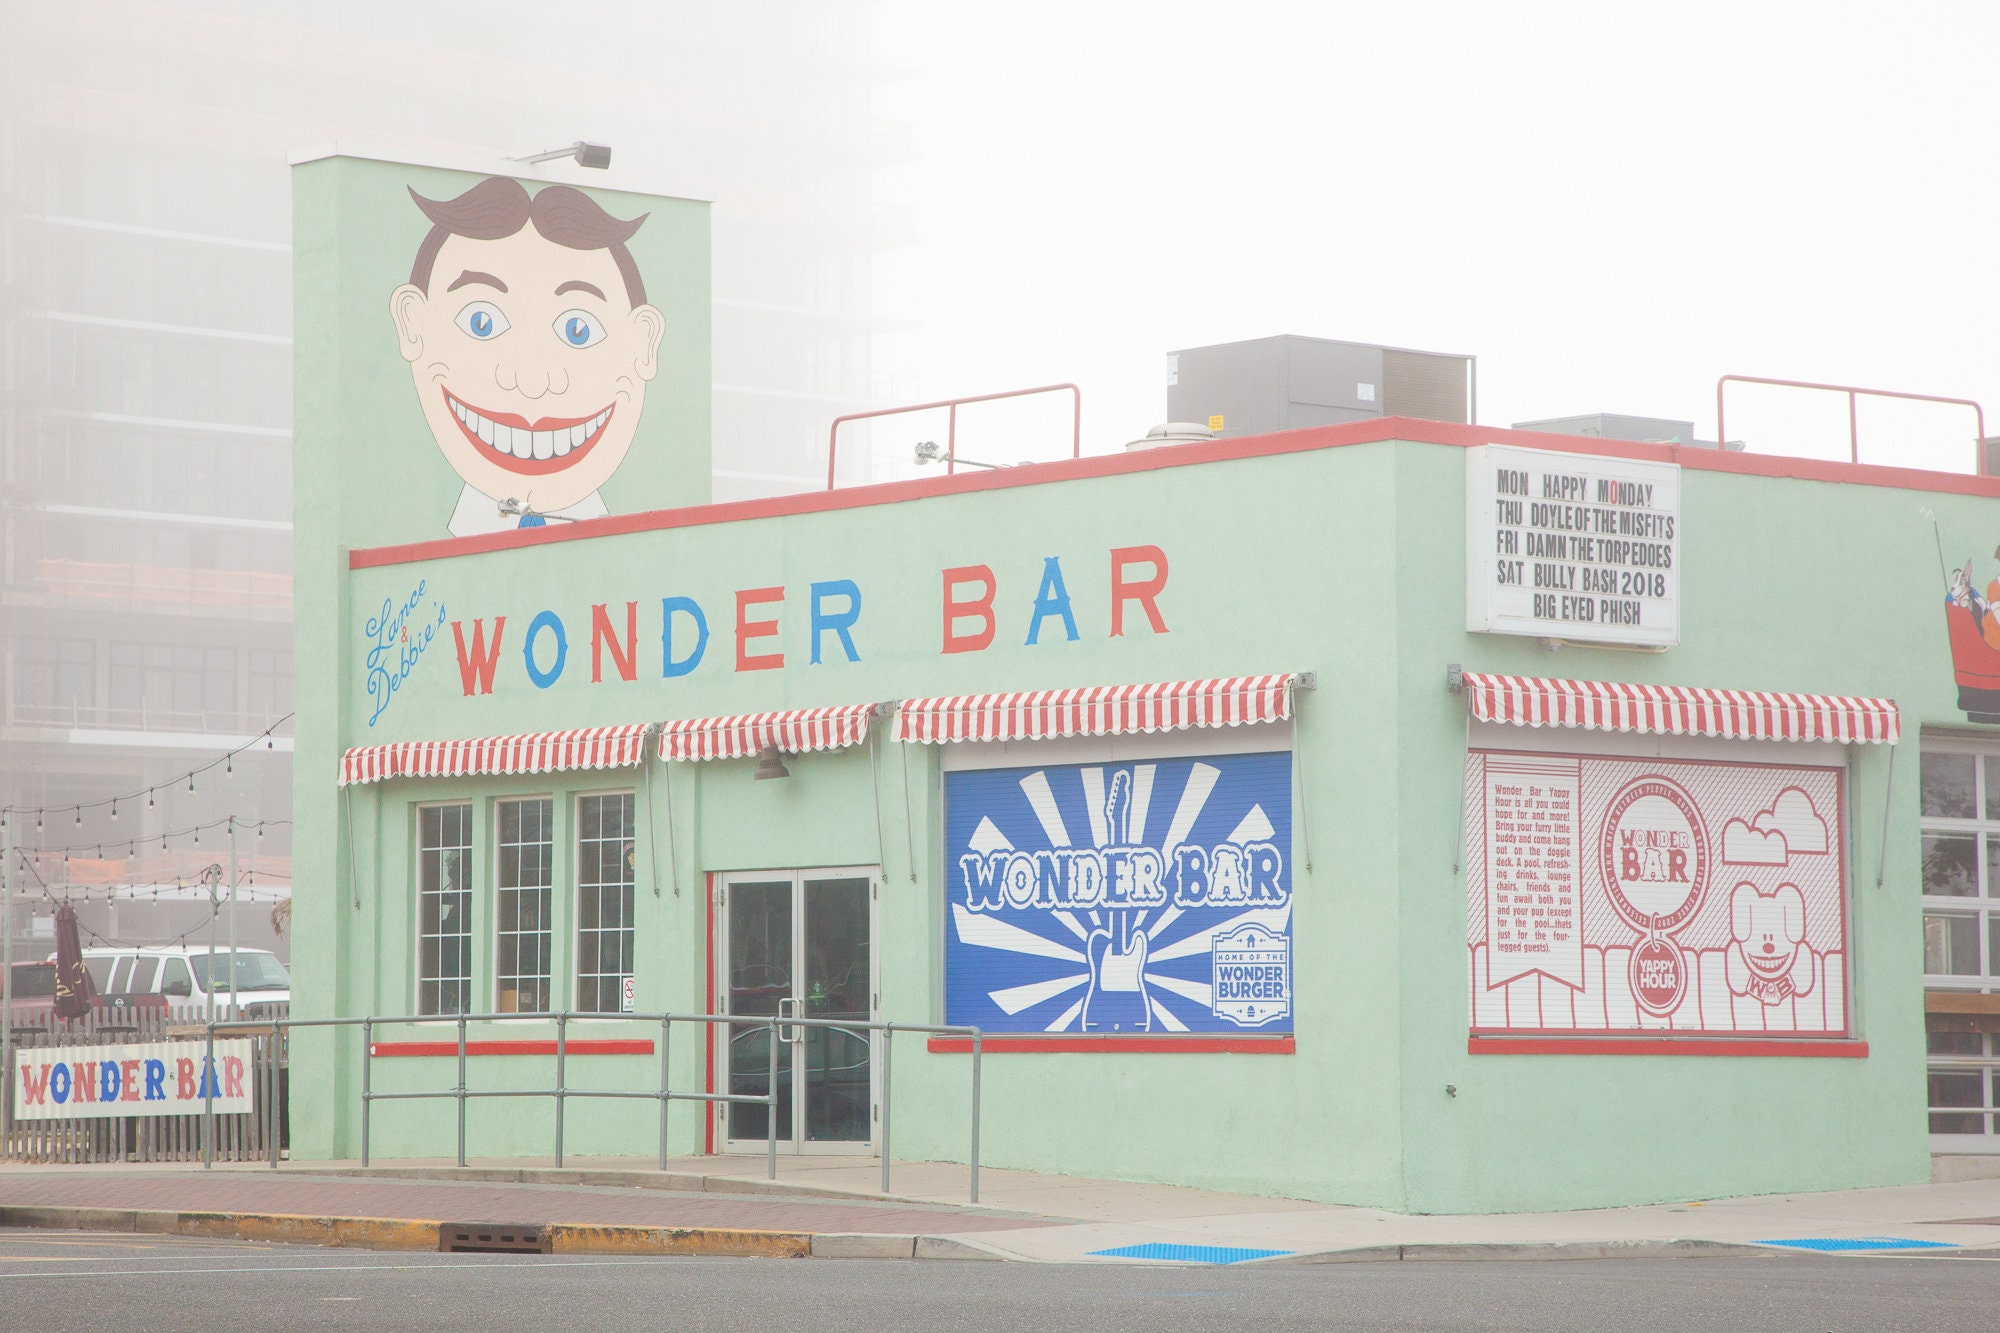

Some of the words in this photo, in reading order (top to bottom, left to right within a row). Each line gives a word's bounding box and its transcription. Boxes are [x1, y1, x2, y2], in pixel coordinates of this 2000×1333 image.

[1497, 469, 1529, 496] MON
[1543, 474, 1587, 501] HAPPY
[1598, 479, 1653, 508] MONDAY
[1496, 499, 1523, 525] THU
[1531, 502, 1573, 530] DOYLE
[1575, 506, 1591, 532] OF
[1592, 508, 1617, 534] THE
[1619, 511, 1674, 540] MISFITS
[1497, 530, 1518, 555] FRI
[1526, 532, 1567, 559] DAMN
[1569, 536, 1594, 561] THE
[1596, 539, 1672, 569] TORPEDOES
[1497, 559, 1524, 585] SAT
[1534, 563, 1576, 590] BULLY
[1583, 567, 1618, 594] BASH
[1621, 572, 1666, 598] 2018
[1534, 593, 1556, 619] BIG
[1562, 595, 1594, 622] EYED
[1601, 599, 1641, 626] PHISH
[366, 579, 427, 669] Lance
[450, 579, 862, 696] WONDER
[940, 544, 1170, 655] BAR
[400, 626, 408, 643] &
[366, 602, 446, 727] Debbie's
[1495, 785, 1522, 795] Wonder
[1530, 786, 1542, 796] Bar
[1549, 787, 1570, 798] Yappy
[1495, 797, 1512, 807] Hour
[1515, 798, 1521, 807] is
[1524, 798, 1533, 808] all
[1536, 800, 1548, 809] you
[1552, 800, 1570, 809] could
[1615, 787, 1643, 817] BETWEEN
[1496, 809, 1512, 819] hope
[1518, 810, 1527, 819] for
[1532, 811, 1545, 820] and
[1550, 812, 1570, 821] more!
[1496, 821, 1514, 832] Bring
[1517, 823, 1532, 832] your
[1536, 822, 1551, 833] furry
[1554, 823, 1570, 833] little
[1605, 819, 1617, 848] UNION
[1496, 833, 1516, 844] buddy
[1519, 834, 1532, 843] and
[1534, 836, 1551, 844] come
[1554, 835, 1570, 846] hang
[1620, 829, 1689, 848] WONDER
[1496, 846, 1508, 855] out
[1514, 847, 1522, 855] on
[1530, 846, 1540, 856] the
[1547, 847, 1571, 858] doggie
[1496, 857, 1514, 867] deck.
[1517, 858, 1521, 867] A
[1524, 858, 1541, 869] pool,
[1544, 859, 1571, 868] refresh-
[1620, 847, 1690, 883] BAR
[961, 847, 1165, 908] WONDER
[1175, 842, 1286, 908] BAR
[1496, 869, 1507, 879] ing
[1516, 870, 1539, 880] drinks,
[1548, 871, 1571, 882] lounge
[1693, 866, 1704, 895] TIMES
[1496, 881, 1519, 892] chairs,
[1526, 882, 1550, 892] friends
[1558, 884, 1571, 893] and
[1497, 893, 1508, 903] fun
[1514, 894, 1532, 904] await
[1538, 894, 1554, 904] both
[1560, 897, 1571, 905] you
[1677, 897, 1695, 917] SINCE
[1497, 906, 1510, 915] and
[1513, 908, 1528, 916] your
[1531, 908, 1544, 917] pup
[1547, 908, 1572, 917] (except
[1497, 918, 1507, 927] for
[1515, 918, 1526, 928] the
[1497, 930, 1510, 940] just
[1518, 930, 1528, 940] for
[1535, 931, 1546, 940] the
[1553, 931, 1570, 940] four-
[1498, 942, 1521, 953] legged
[1524, 943, 1551, 953] guests).
[1219, 966, 1283, 981] WONDER
[1640, 959, 1675, 974] YAPPY
[1640, 972, 1676, 989] HOUR
[1219, 982, 1284, 998] BURGER
[20, 1058, 166, 1106] WONDER
[176, 1055, 245, 1101] BAR
